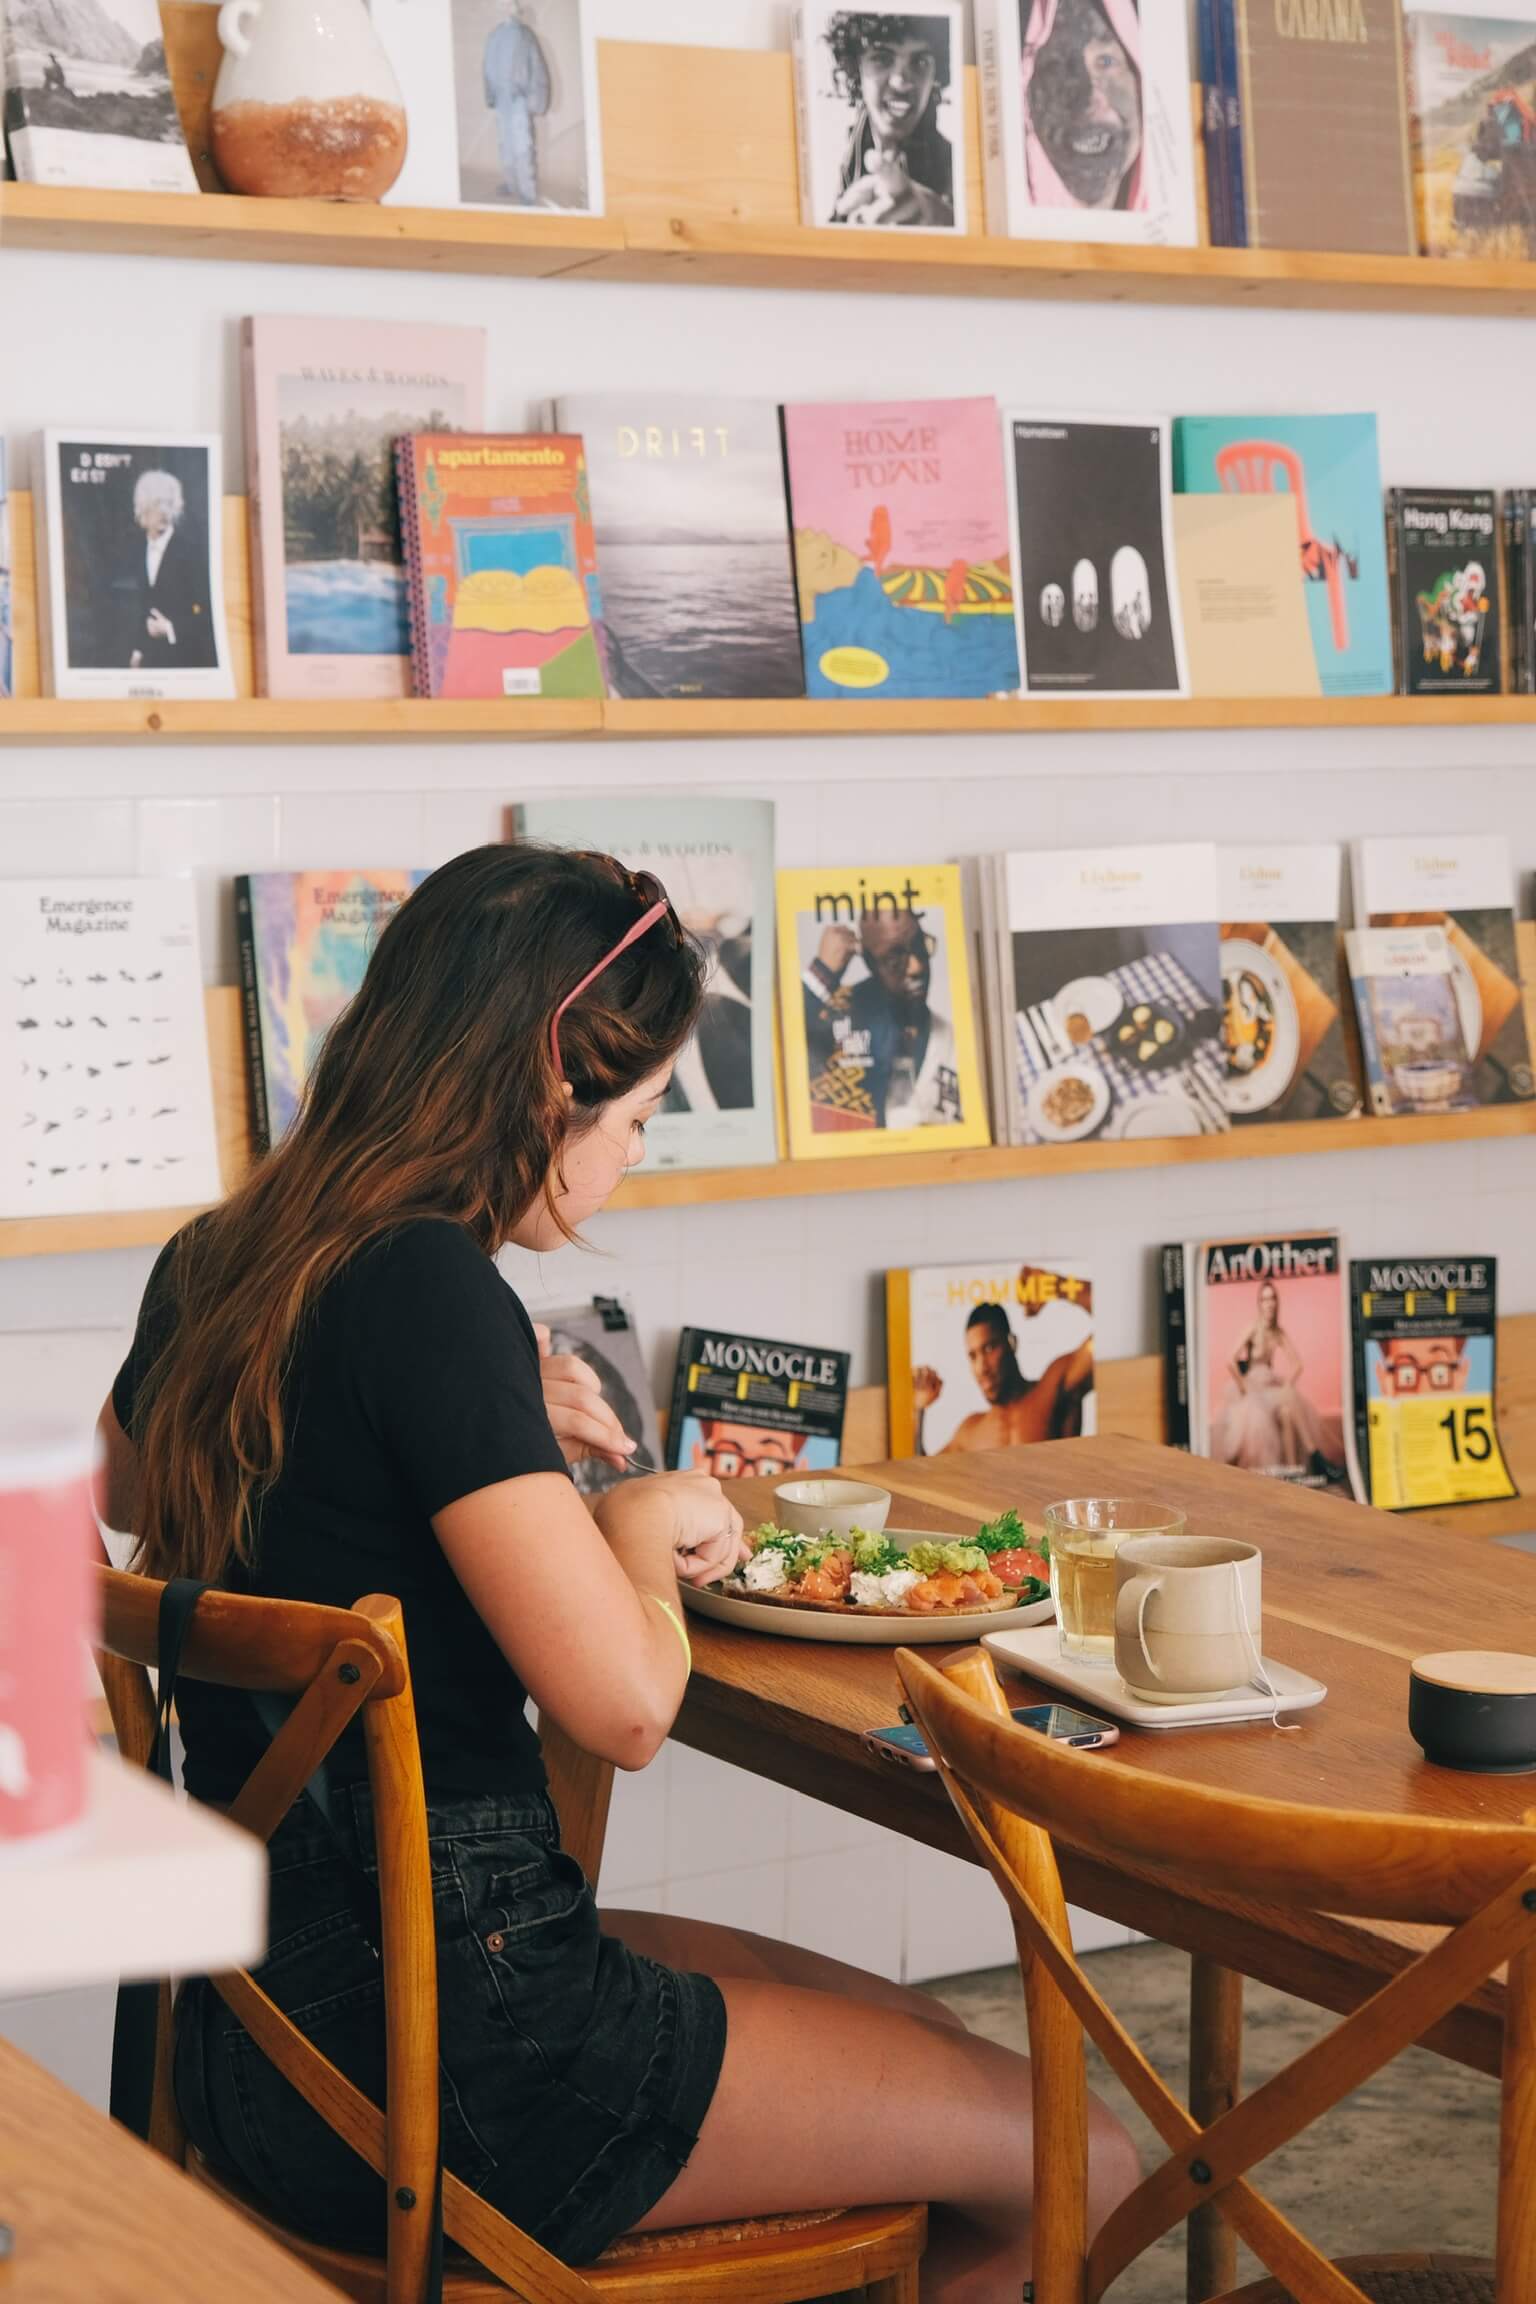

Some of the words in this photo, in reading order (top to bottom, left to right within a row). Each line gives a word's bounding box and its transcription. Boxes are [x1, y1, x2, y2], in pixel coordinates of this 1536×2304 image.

[843, 426, 938, 456] HOME
[438, 447, 566, 472] apartamento
[844, 458, 943, 488] TOWN
[1403, 507, 1448, 535] Hong
[1448, 508, 1493, 536] Kong
[39, 896, 134, 916] Emergence
[314, 888, 405, 908] Emergence
[815, 878, 926, 923] mint
[46, 916, 130, 935] Magazine
[1206, 1240, 1333, 1283] AnOther
[1369, 1264, 1487, 1292] MONOCLE
[700, 1338, 838, 1386] MONOCLE
[1439, 1407, 1492, 1464] 15
